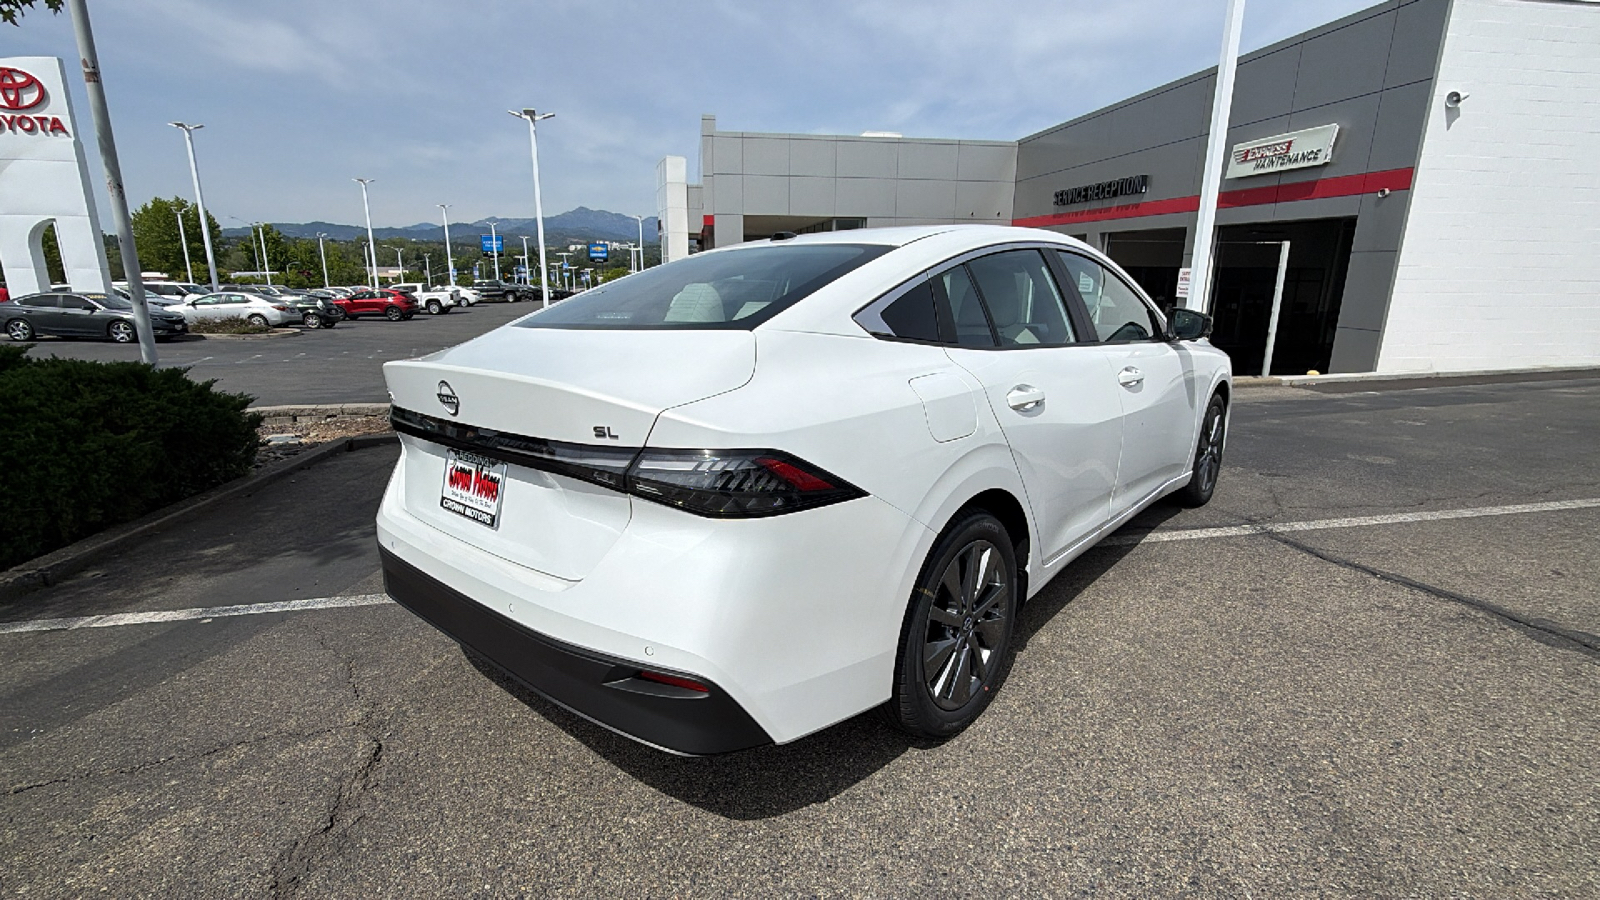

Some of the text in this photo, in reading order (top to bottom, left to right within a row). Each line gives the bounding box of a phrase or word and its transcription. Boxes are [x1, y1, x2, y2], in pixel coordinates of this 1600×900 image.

[0, 115, 68, 133] YOTA
[1246, 142, 1289, 160] EXPRESS
[1253, 148, 1322, 171] MAINTENANCE
[1053, 175, 1148, 206] SERVICE RECEPTION
[593, 426, 619, 440] SL
[460, 452, 490, 467] REDDING
[443, 499, 465, 514] CROWN
[465, 506, 492, 524] MOTORS
